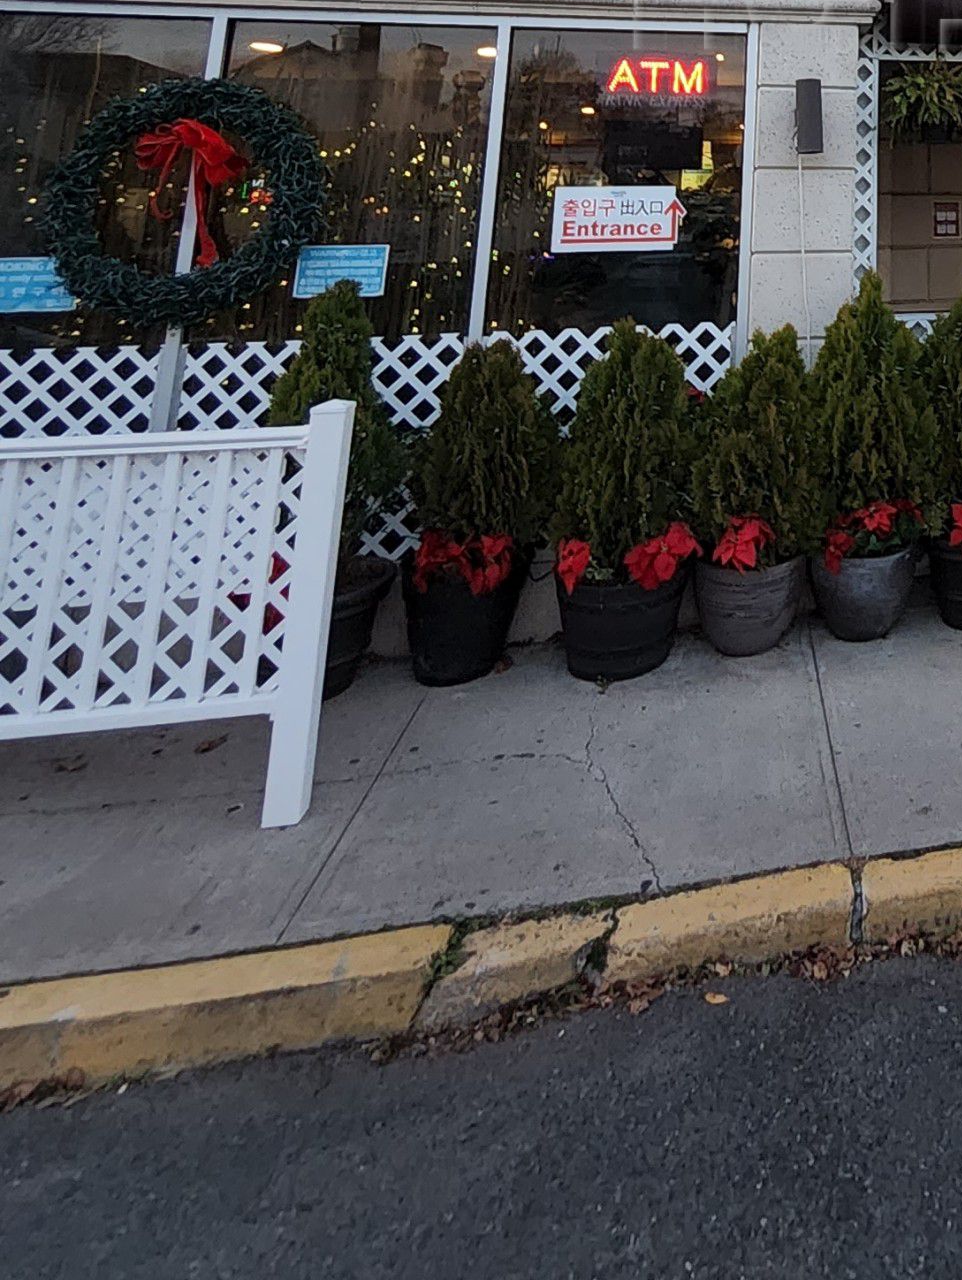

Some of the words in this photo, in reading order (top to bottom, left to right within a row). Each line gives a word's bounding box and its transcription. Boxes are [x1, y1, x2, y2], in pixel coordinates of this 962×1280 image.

[607, 56, 707, 94] ATM
[562, 199, 616, 218] 출입구
[620, 200, 664, 216] 出入口
[562, 220, 663, 238] Entrance
